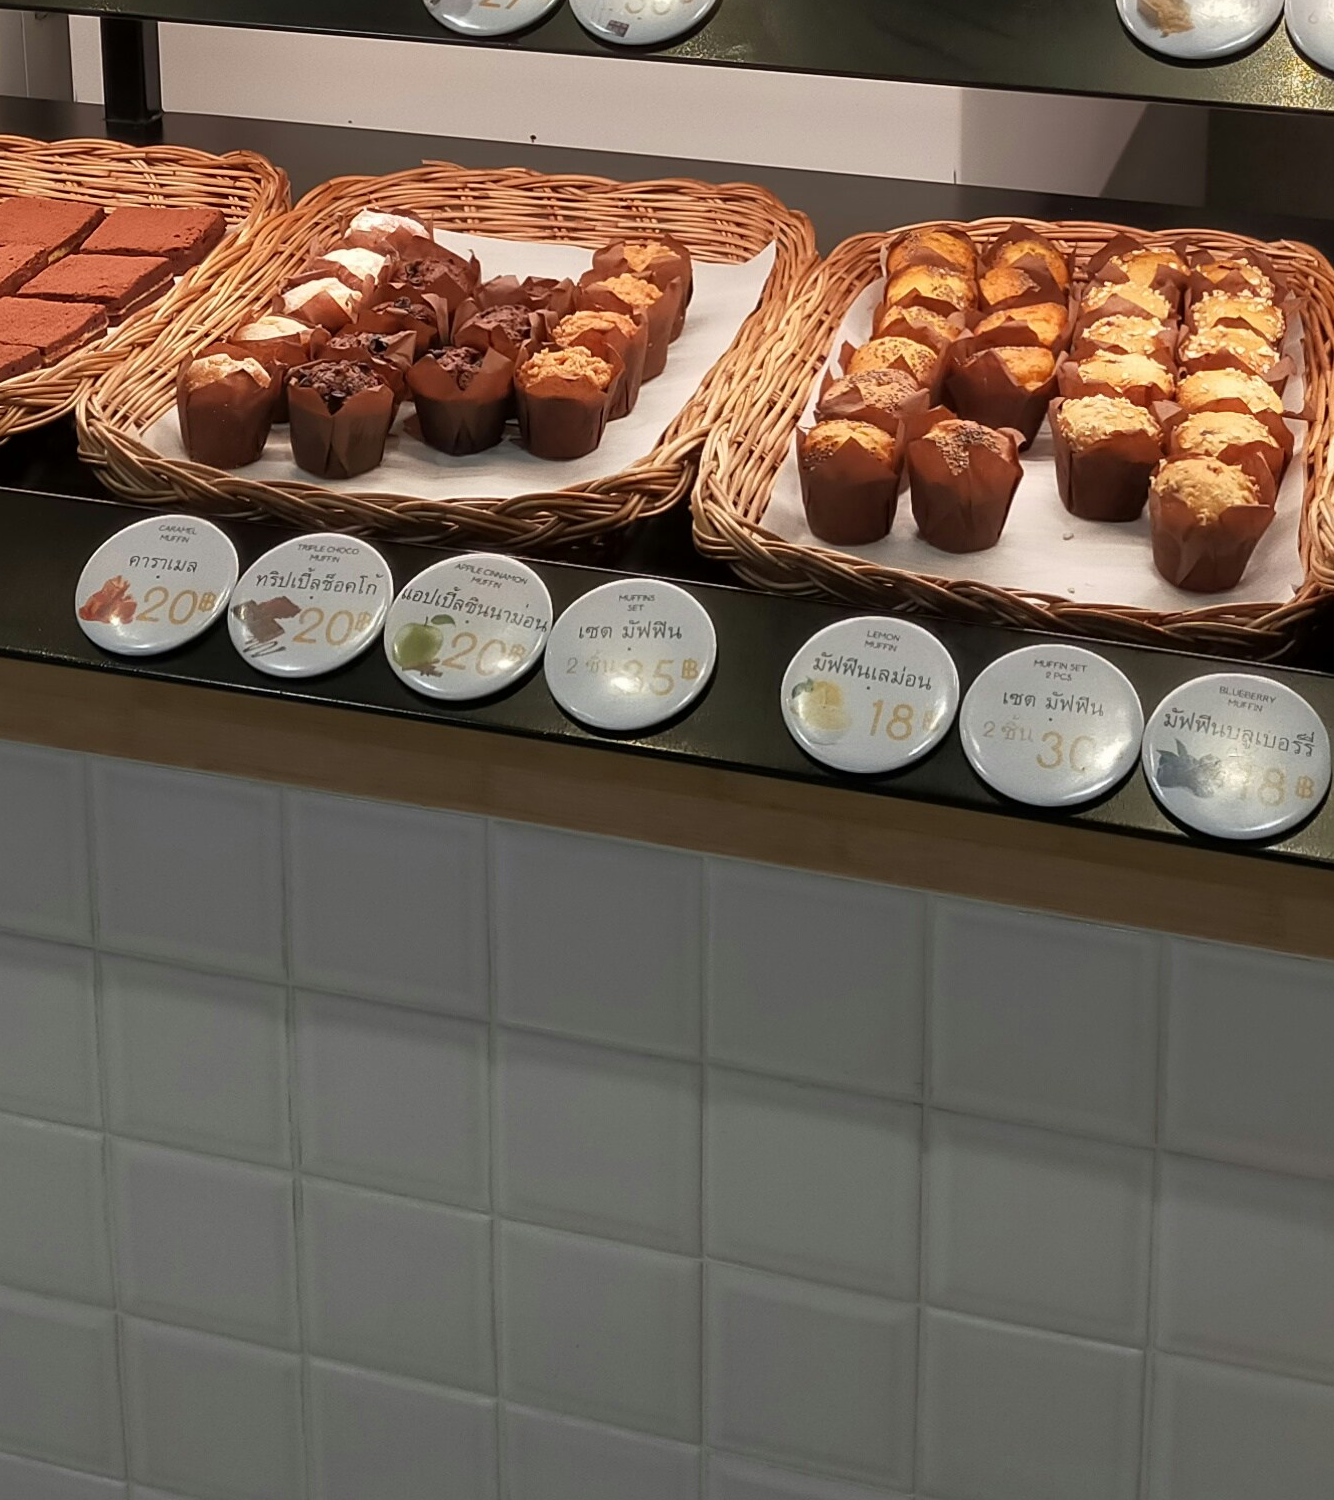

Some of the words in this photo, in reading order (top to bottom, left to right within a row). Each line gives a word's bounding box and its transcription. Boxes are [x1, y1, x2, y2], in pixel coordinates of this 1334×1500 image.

[158, 524, 197, 535] CARAMEL
[159, 534, 190, 544] MUFFIN
[298, 544, 327, 554] TRIPLE
[327, 547, 360, 555] CHOCO
[309, 555, 340, 564] MUFFIN
[454, 562, 481, 575] APPLE
[480, 567, 529, 585] CINNAMON
[471, 577, 502, 589] MUFFIN
[618, 594, 656, 603] MUFFINS
[627, 604, 644, 612] SET
[866, 629, 901, 642] LEMON
[864, 640, 897, 653] MUFFIN
[566, 657, 579, 675] 2
[1033, 659, 1068, 671] MUFFIN
[1070, 663, 1088, 673] SET
[1218, 685, 1277, 704] BLUEBERRY
[1227, 698, 1264, 713] MUFFIN
[982, 720, 996, 739] 2
